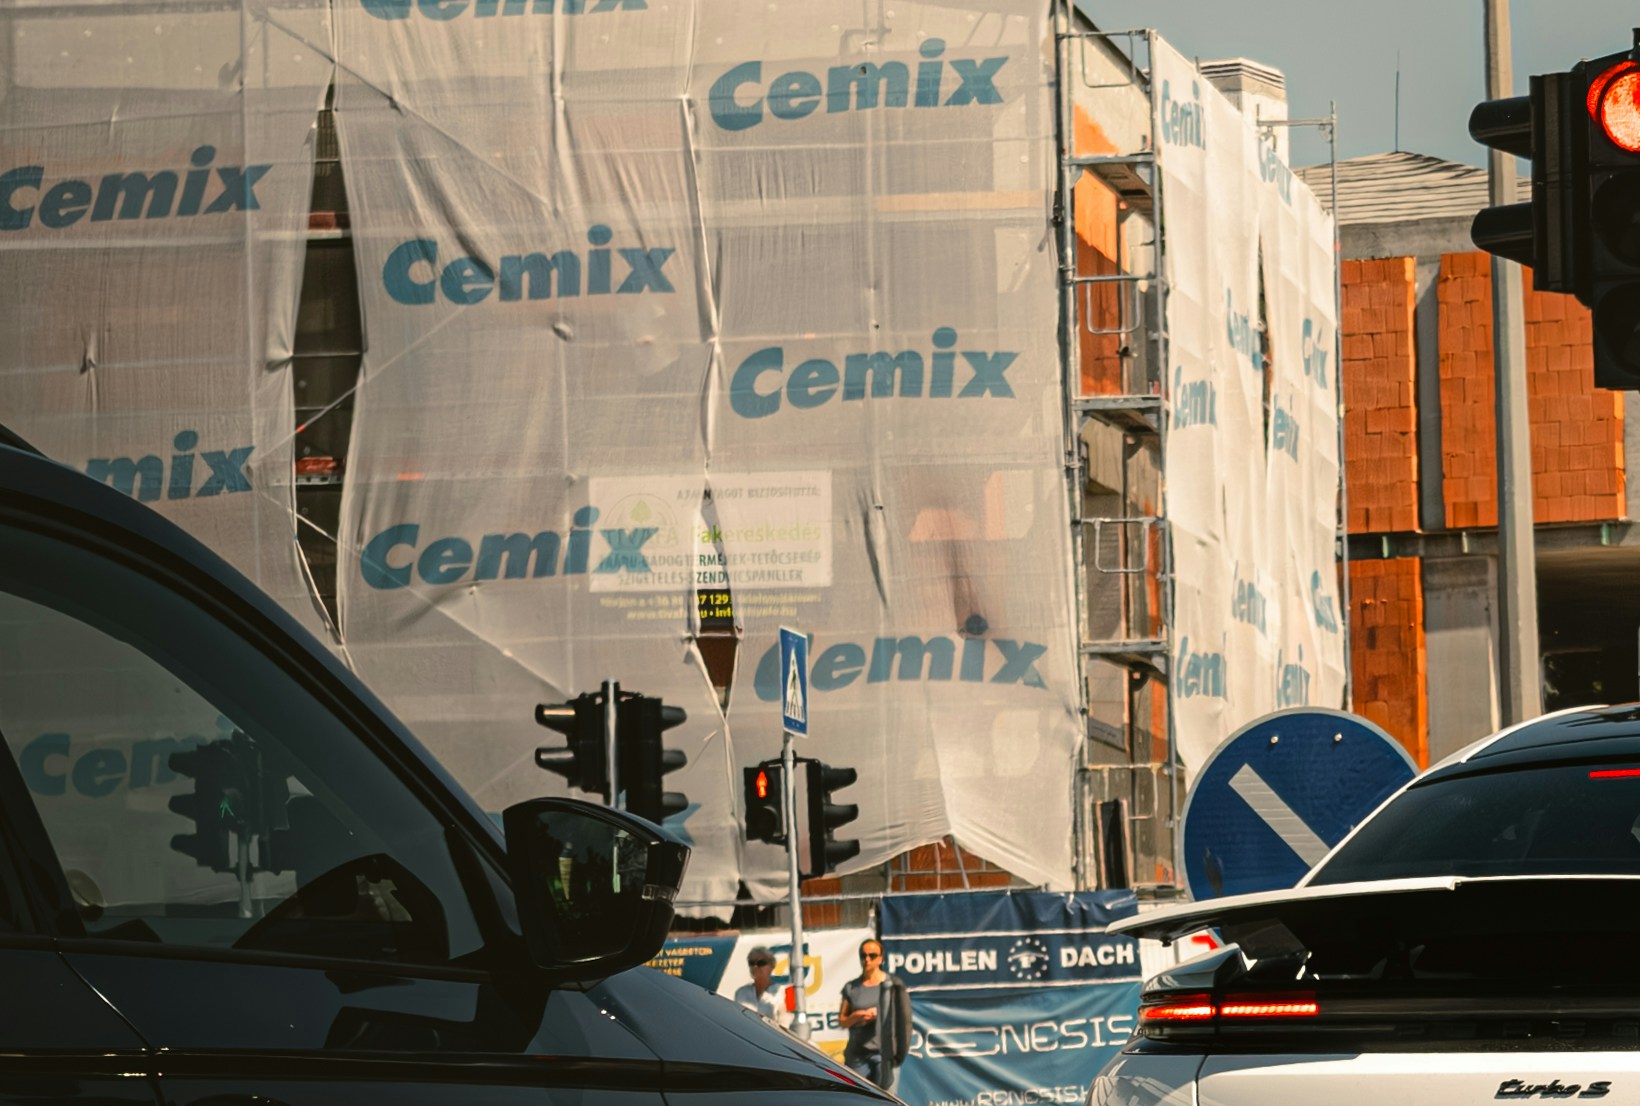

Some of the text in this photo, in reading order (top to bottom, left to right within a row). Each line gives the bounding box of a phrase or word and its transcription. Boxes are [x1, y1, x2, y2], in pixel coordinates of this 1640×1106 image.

[708, 39, 1010, 131] Cemix
[1161, 79, 1206, 150] Cemi
[0, 144, 273, 231] Cemix
[381, 224, 676, 305] Cemix
[729, 326, 1023, 419] Cemix
[86, 430, 255, 501] mix
[360, 505, 659, 590] Cemix
[1177, 635, 1228, 701] Cem
[889, 949, 997, 974] POHLEN
[1061, 944, 1135, 968] DACH
[1495, 1078, 1612, 1099] turbo S
